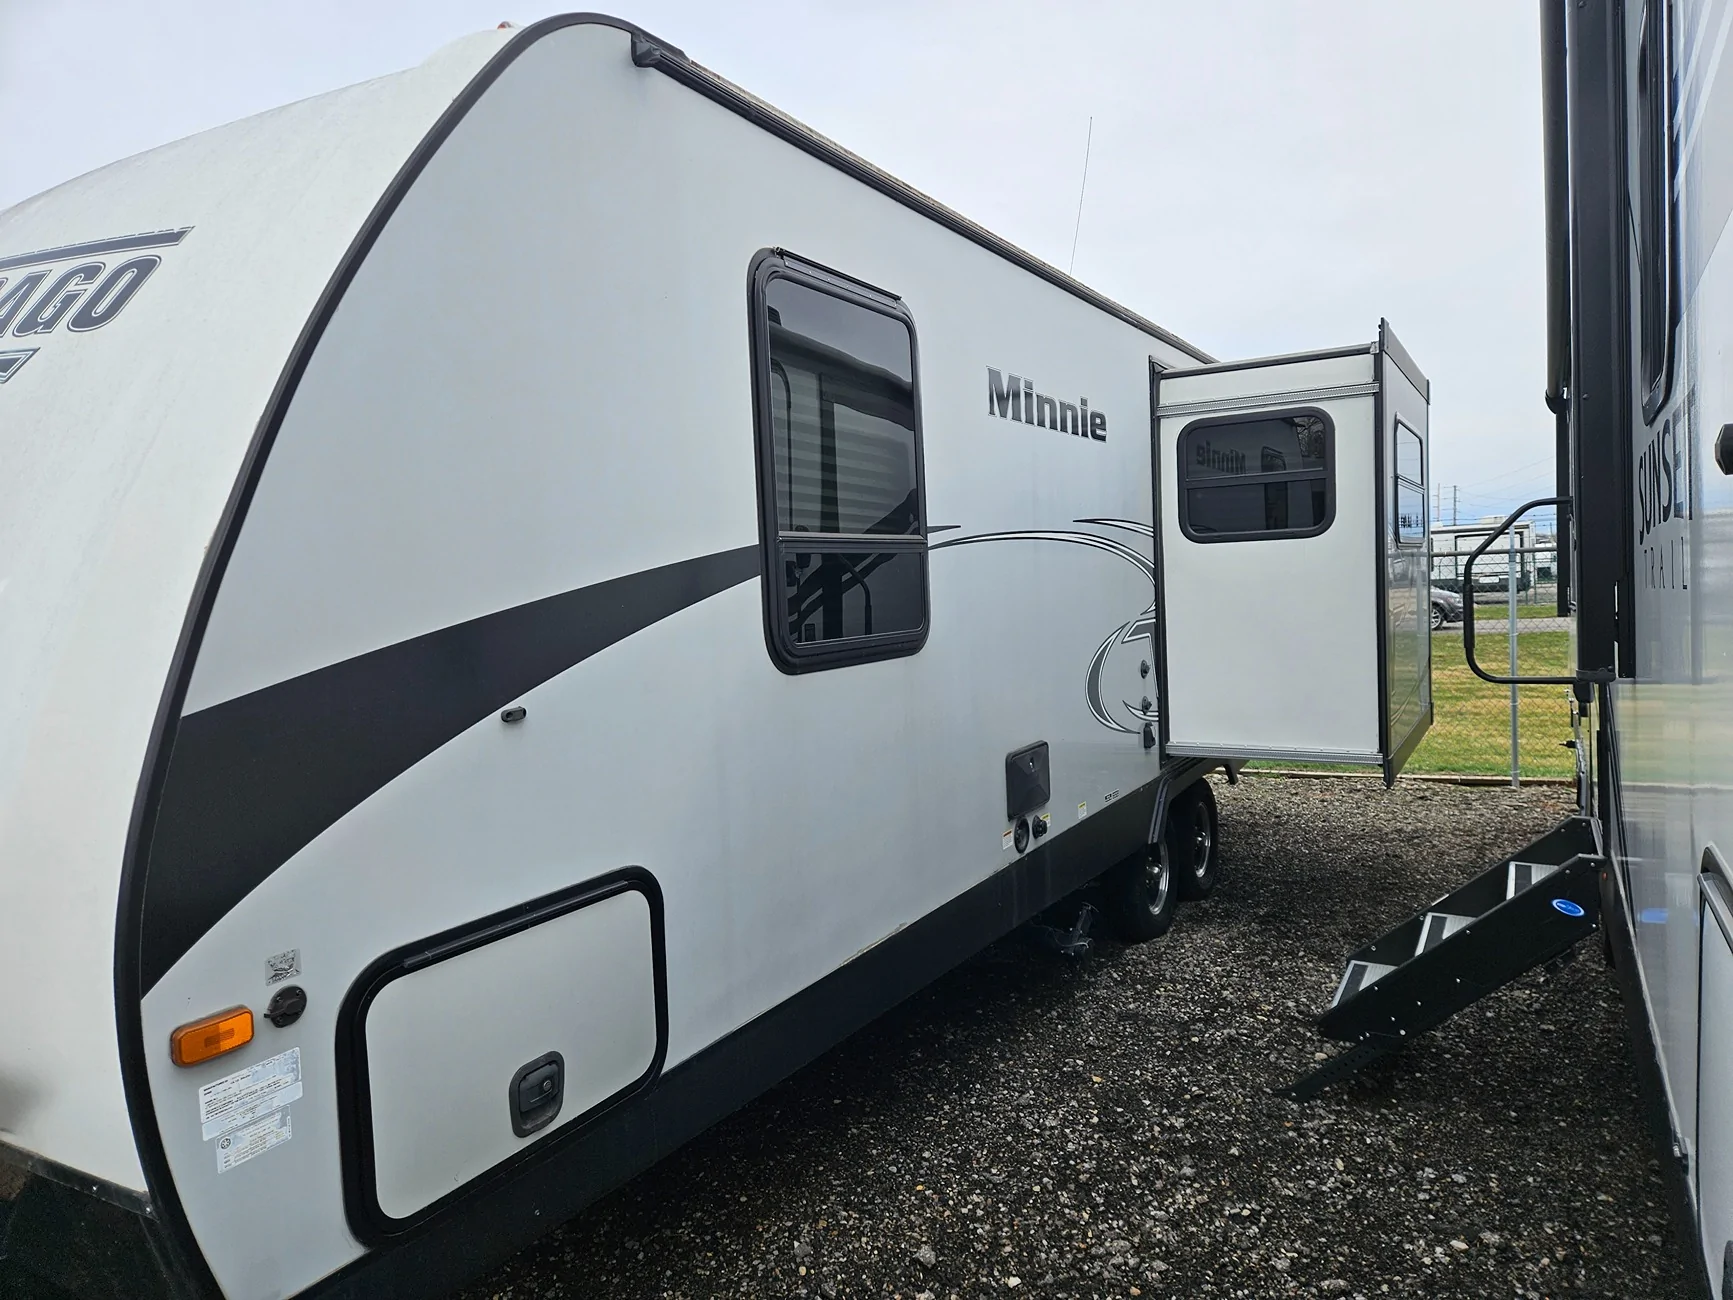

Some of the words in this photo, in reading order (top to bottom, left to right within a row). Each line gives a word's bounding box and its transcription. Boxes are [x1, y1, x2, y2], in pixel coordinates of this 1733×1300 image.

[0, 254, 163, 338] AGO
[985, 365, 1108, 443] Minnie
[1638, 383, 1696, 546] SUNSET
[1643, 536, 1688, 590] TRAIL
